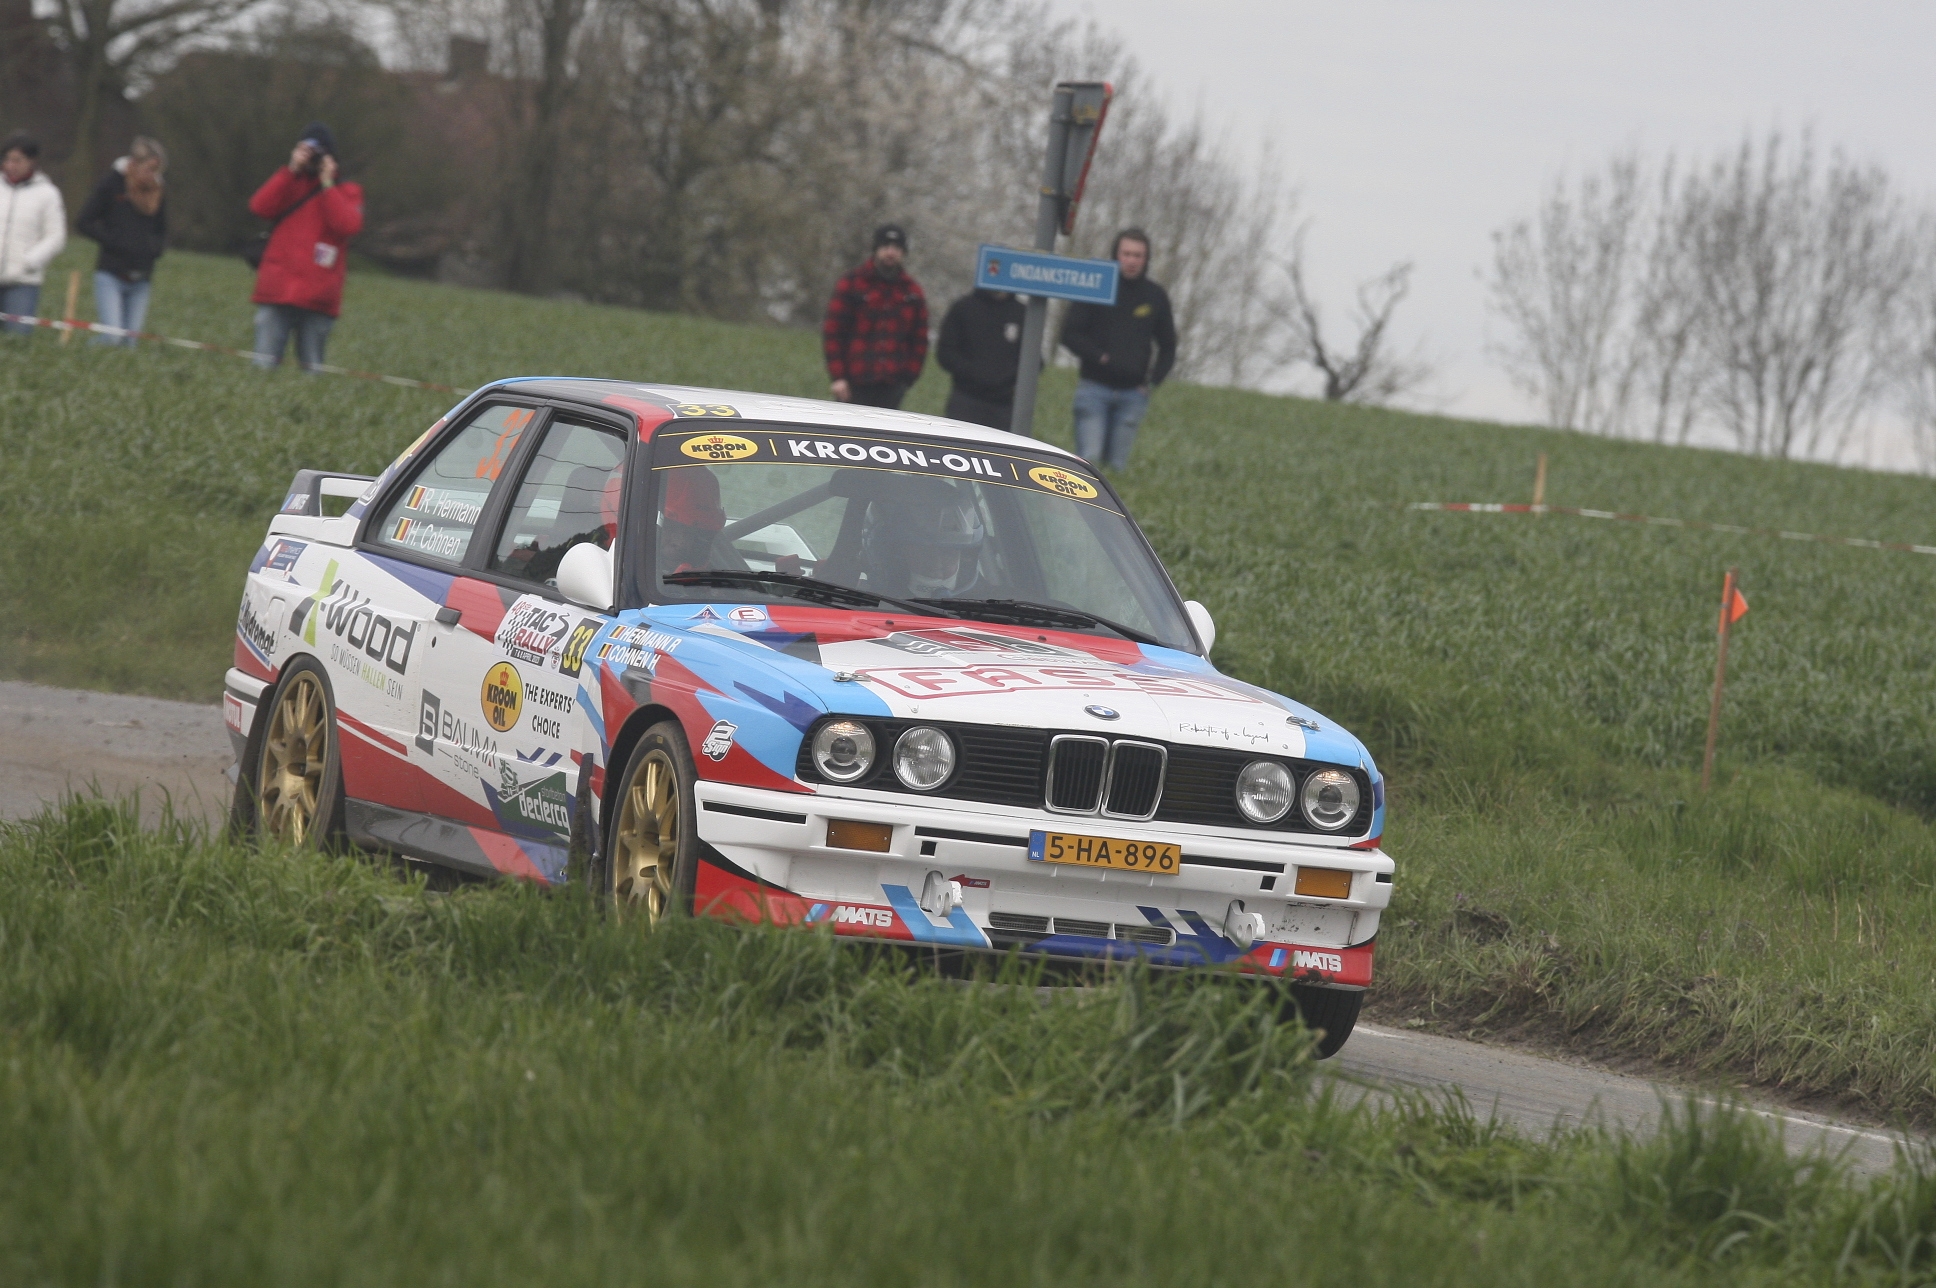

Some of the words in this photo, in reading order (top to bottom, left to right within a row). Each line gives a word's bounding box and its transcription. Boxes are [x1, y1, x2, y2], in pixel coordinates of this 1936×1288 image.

[1009, 262, 1103, 289] ONDANKSTRAAT
[676, 404, 736, 417] 33
[691, 443, 747, 453] KROON
[708, 450, 734, 459] OIL
[787, 439, 1002, 478] KROON-OIL
[1038, 473, 1089, 493] KROON
[1054, 484, 1077, 496] OIL
[419, 488, 435, 513] R.
[432, 489, 482, 526] Hermann
[405, 520, 421, 547] H.
[420, 523, 461, 556] Cohnen
[523, 607, 558, 633] TAC
[514, 628, 555, 655] RALLY
[562, 625, 594, 673] 33
[620, 627, 672, 651] HERMANN
[669, 638, 682, 653] R
[609, 645, 650, 669] COHNEN
[647, 654, 661, 671] H
[361, 662, 386, 691] HALLEN
[387, 678, 404, 701] SEIN
[525, 683, 538, 703] THE
[898, 668, 1224, 697] FASSI
[487, 684, 518, 710] KROON
[492, 706, 506, 727] OIL
[532, 714, 561, 740] CHOICE
[442, 709, 497, 770] BAUMA
[453, 753, 480, 779] stone
[1031, 850, 1040, 858] NL
[1049, 835, 1174, 870] 5-HA-896
[830, 905, 893, 927] MATS
[1292, 949, 1342, 973] MATS
